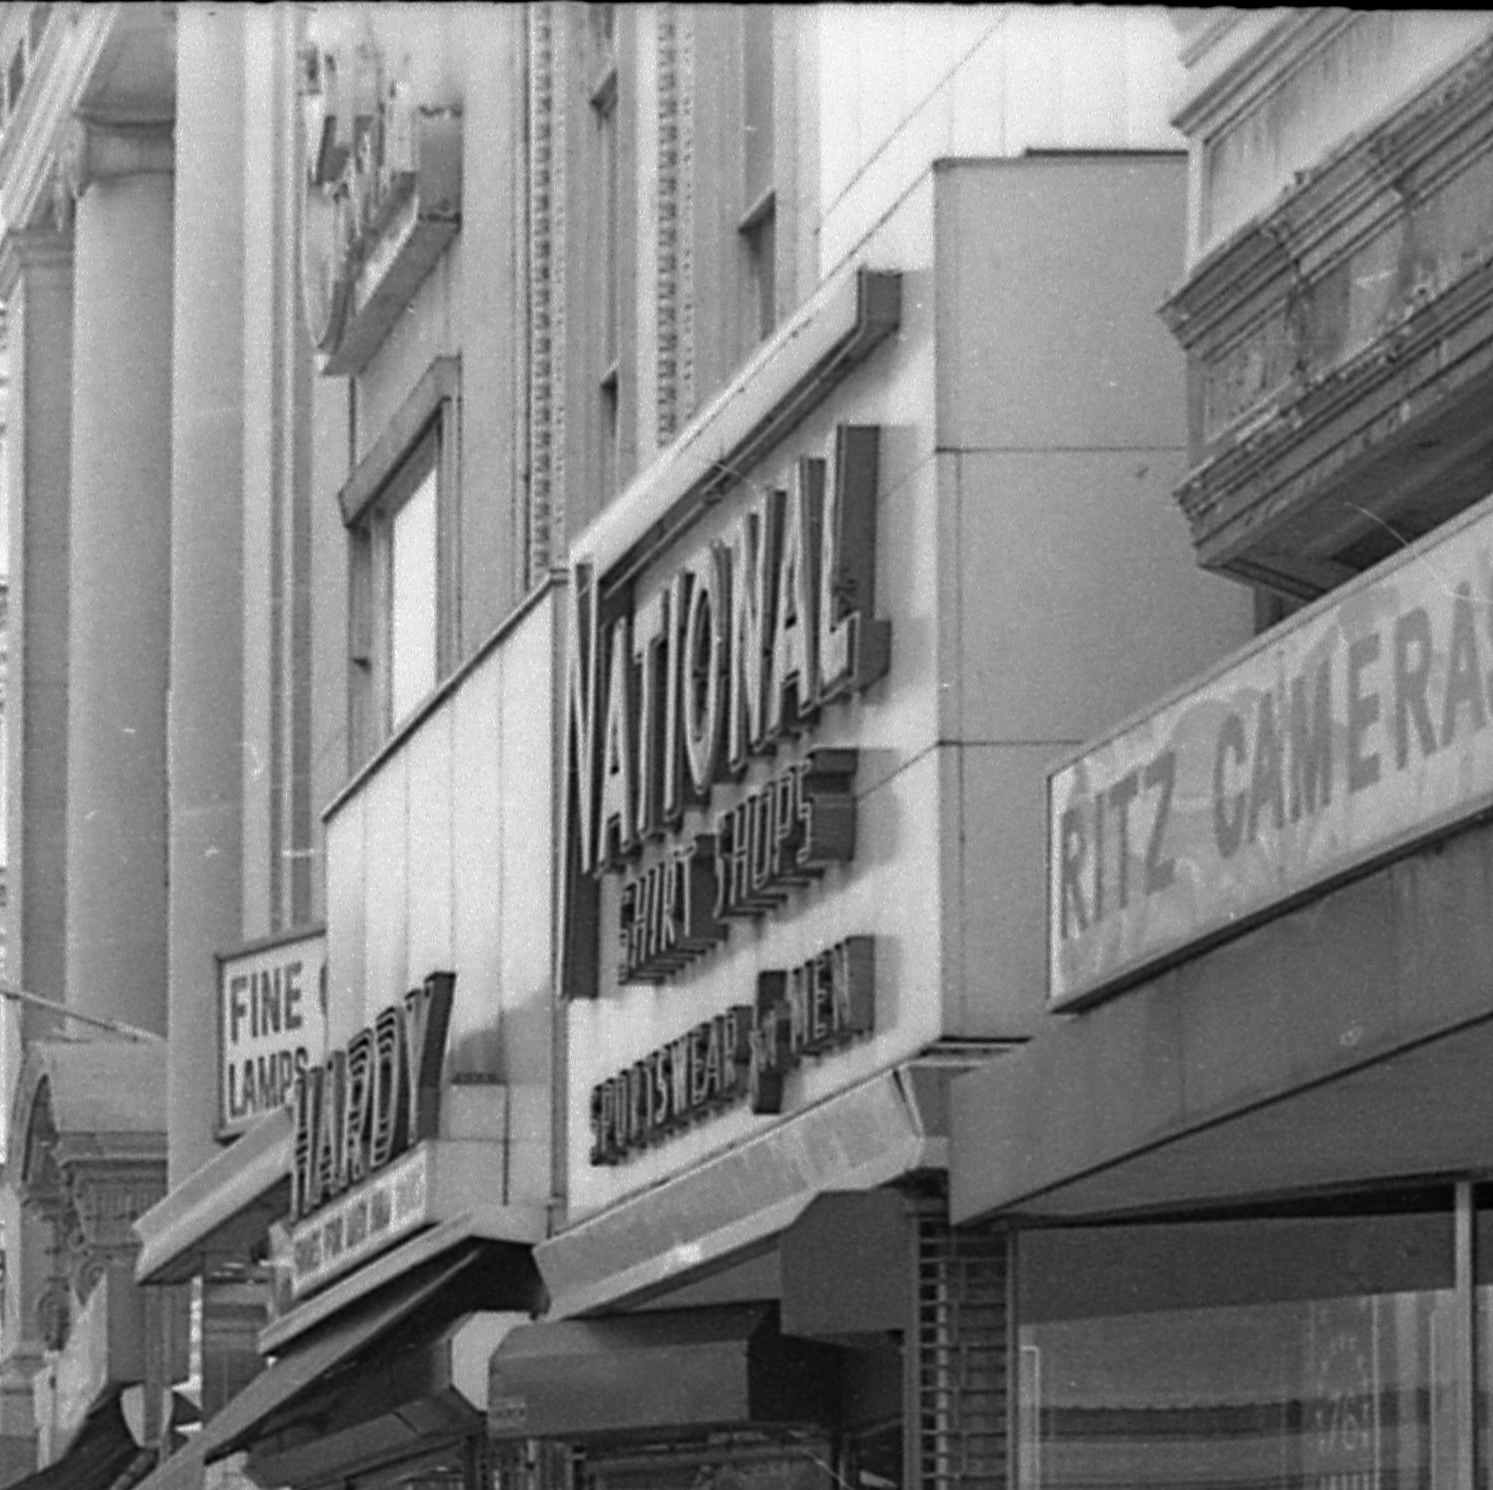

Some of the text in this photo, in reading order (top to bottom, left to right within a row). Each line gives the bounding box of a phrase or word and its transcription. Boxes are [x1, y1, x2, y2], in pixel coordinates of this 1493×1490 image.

[559, 424, 864, 975] NATIONAL
[1061, 560, 1493, 939] RITZ CAMERA
[618, 753, 839, 985] SHIRT SHOPS
[230, 961, 304, 1045] FINE
[790, 936, 870, 1056] MEN
